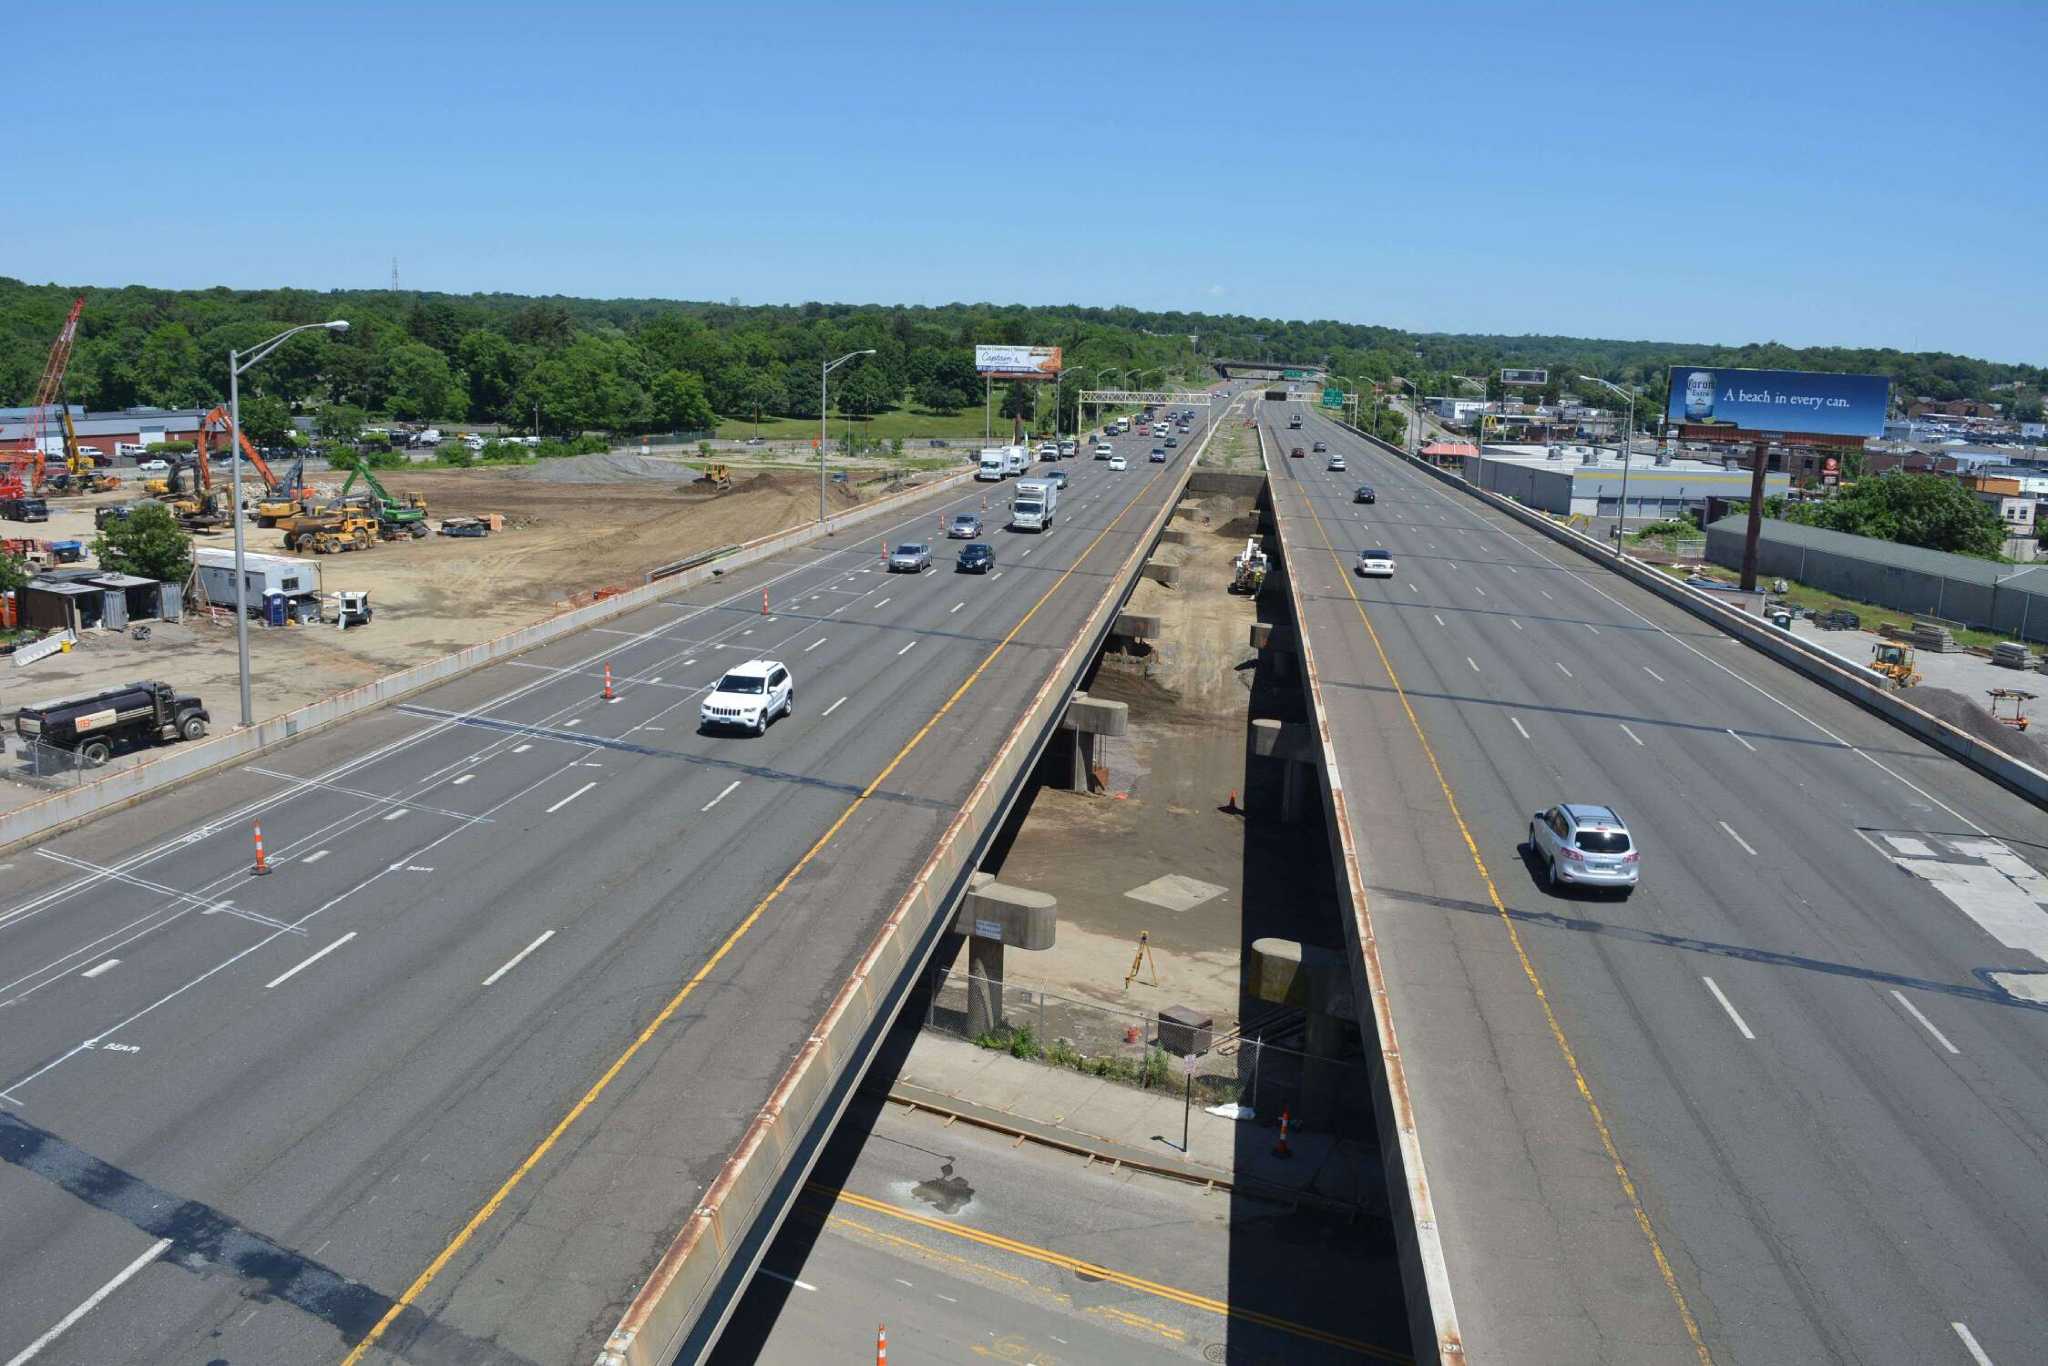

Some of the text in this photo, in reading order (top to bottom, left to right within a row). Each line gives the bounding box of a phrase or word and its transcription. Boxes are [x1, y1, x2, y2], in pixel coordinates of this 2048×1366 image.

[1723, 387, 1850, 410] A beach in every can.
[103, 1042, 141, 1053] BEAM
